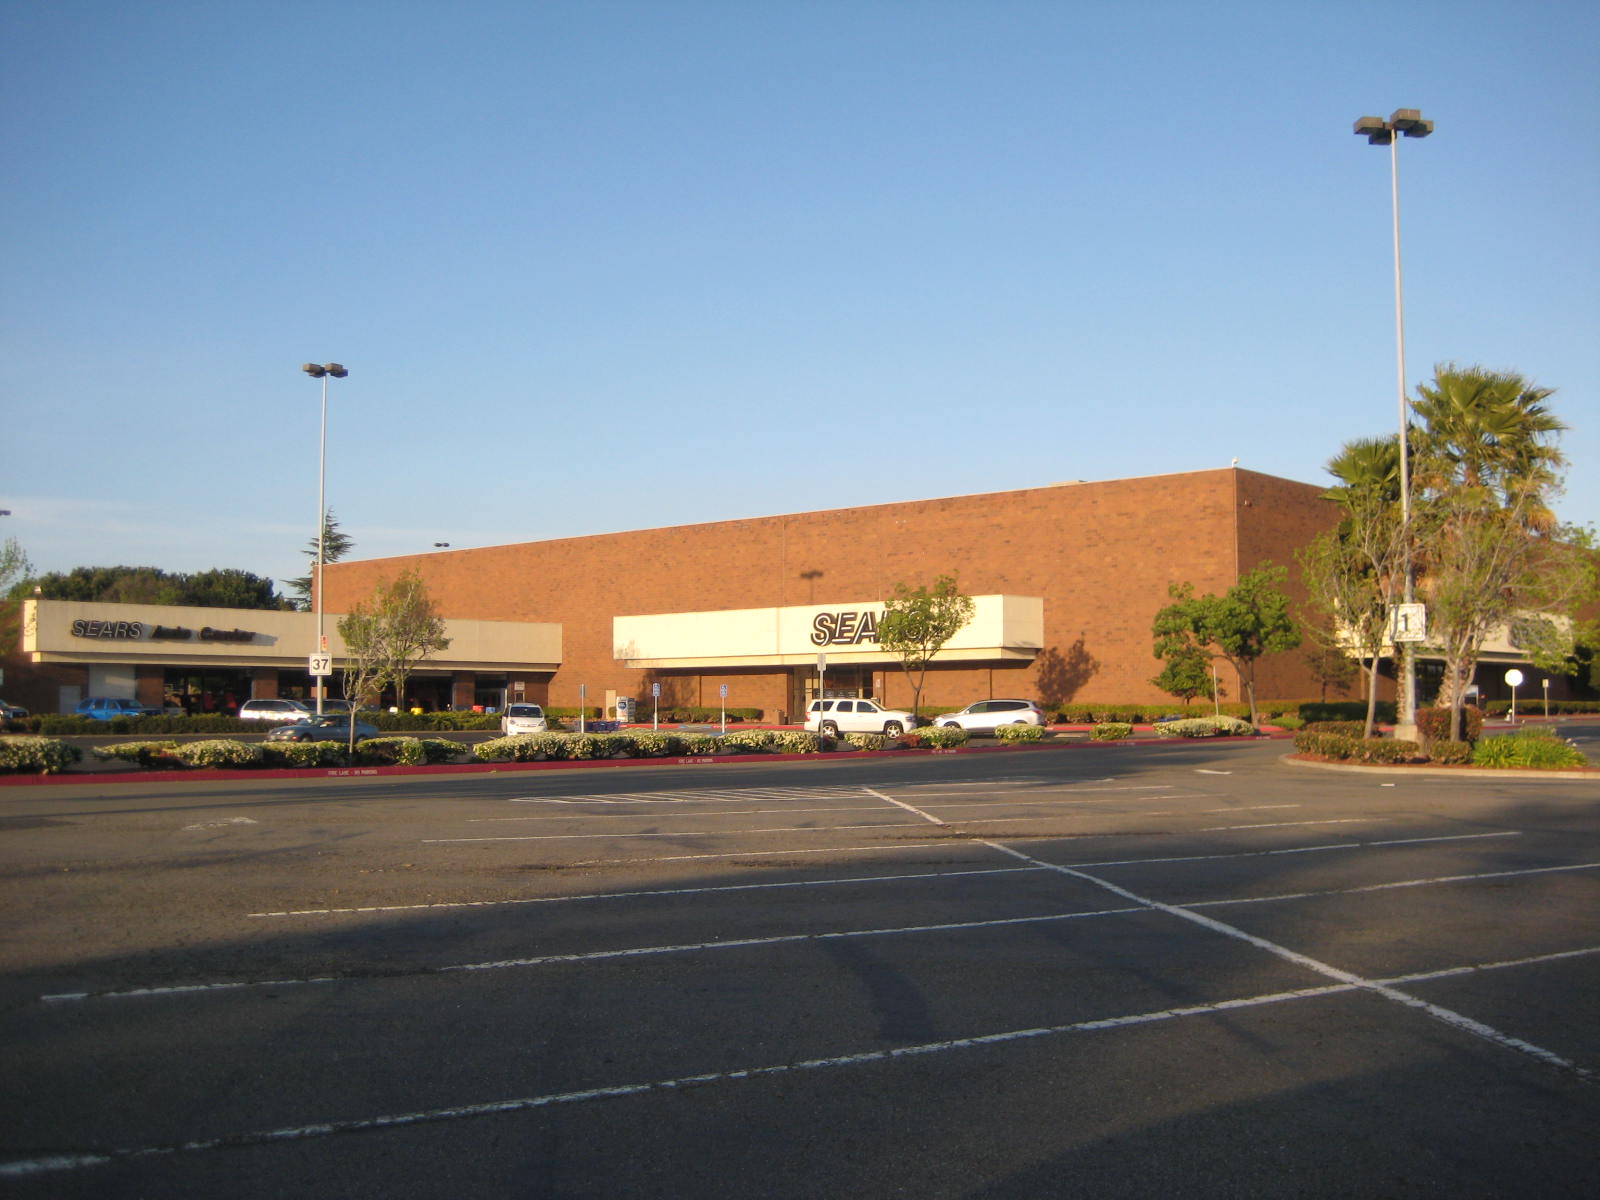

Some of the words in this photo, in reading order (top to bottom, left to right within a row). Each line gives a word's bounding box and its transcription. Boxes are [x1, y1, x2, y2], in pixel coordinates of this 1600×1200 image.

[71, 619, 143, 639] SEARS
[811, 611, 934, 646] SEA
[1400, 613, 1408, 631] 1
[313, 659, 328, 670] 37
